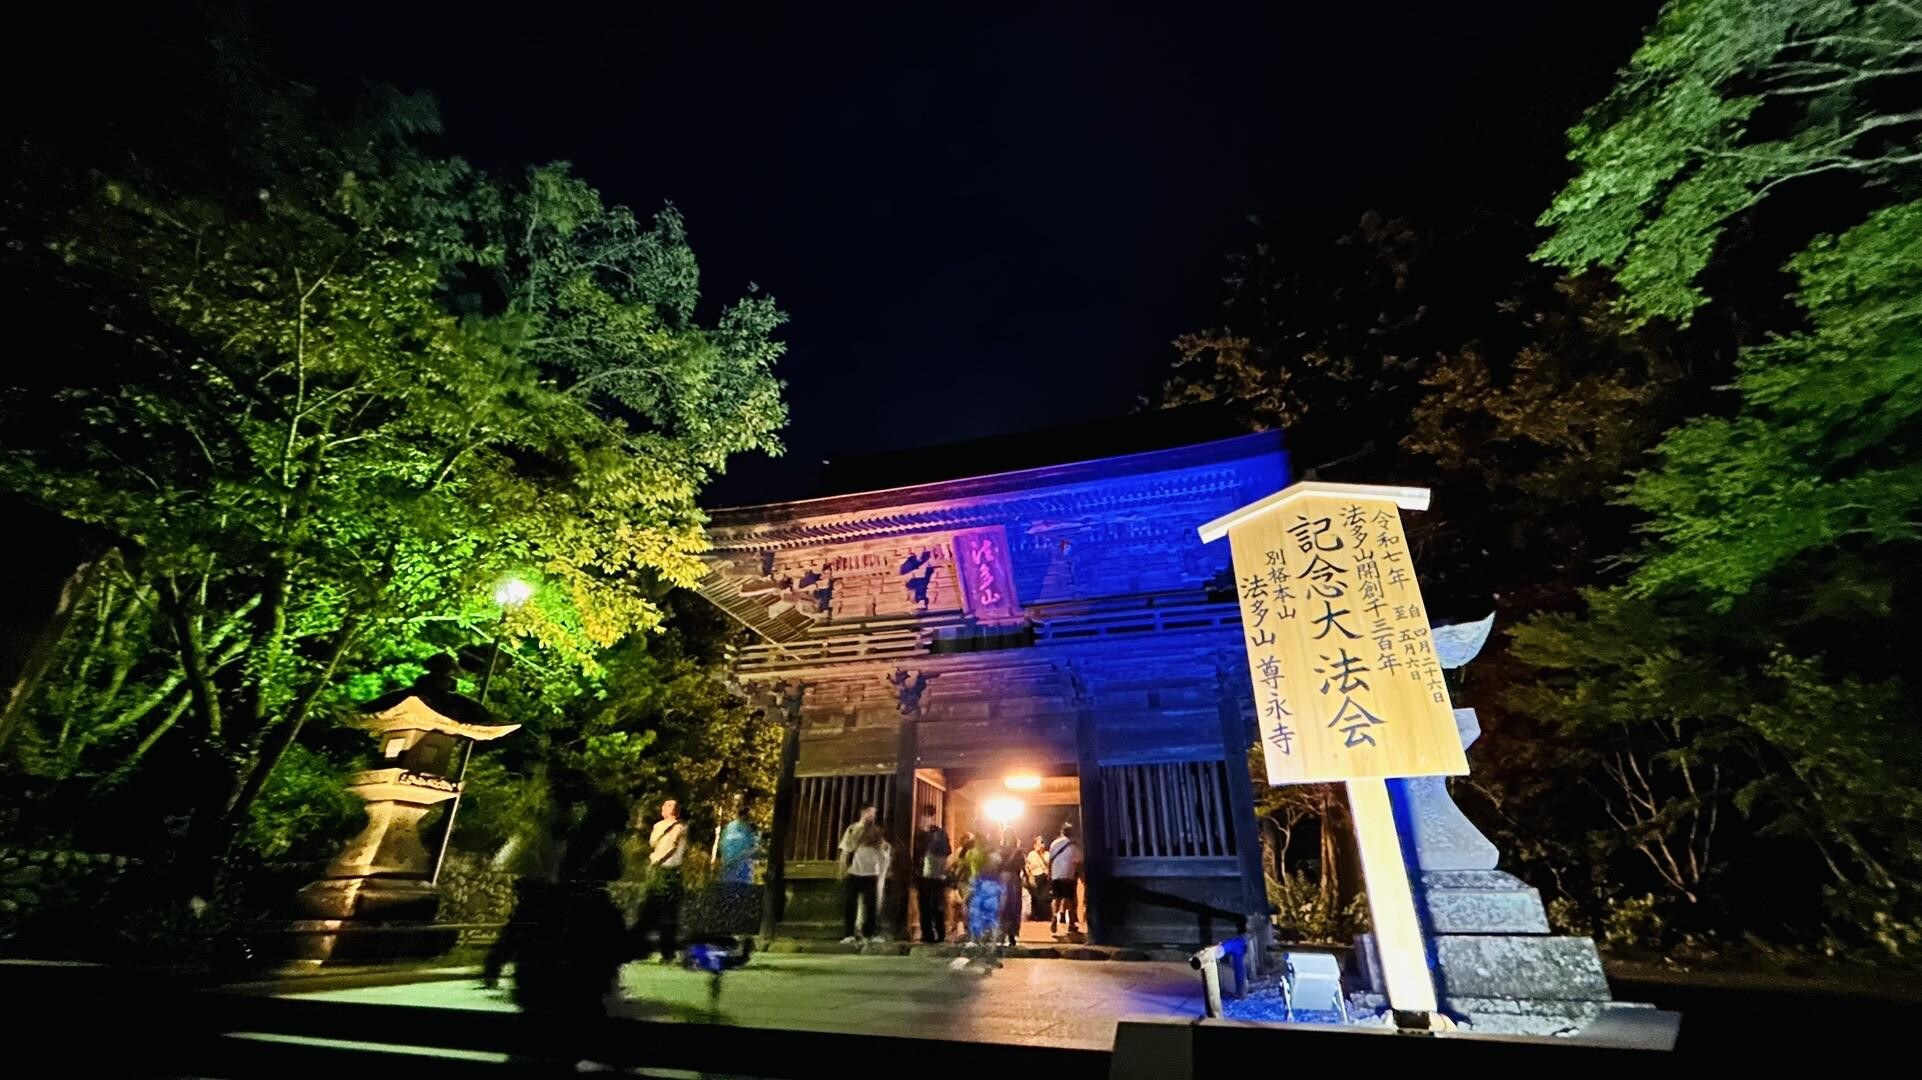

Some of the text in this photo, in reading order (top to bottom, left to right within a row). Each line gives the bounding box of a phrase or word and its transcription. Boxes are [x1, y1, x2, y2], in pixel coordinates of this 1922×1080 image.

[1266, 549, 1296, 620] 別格本山
[1340, 506, 1403, 677] 法多山開創千三百年
[1371, 509, 1411, 591] 令和七年
[1286, 516, 1388, 749] 記念大法会
